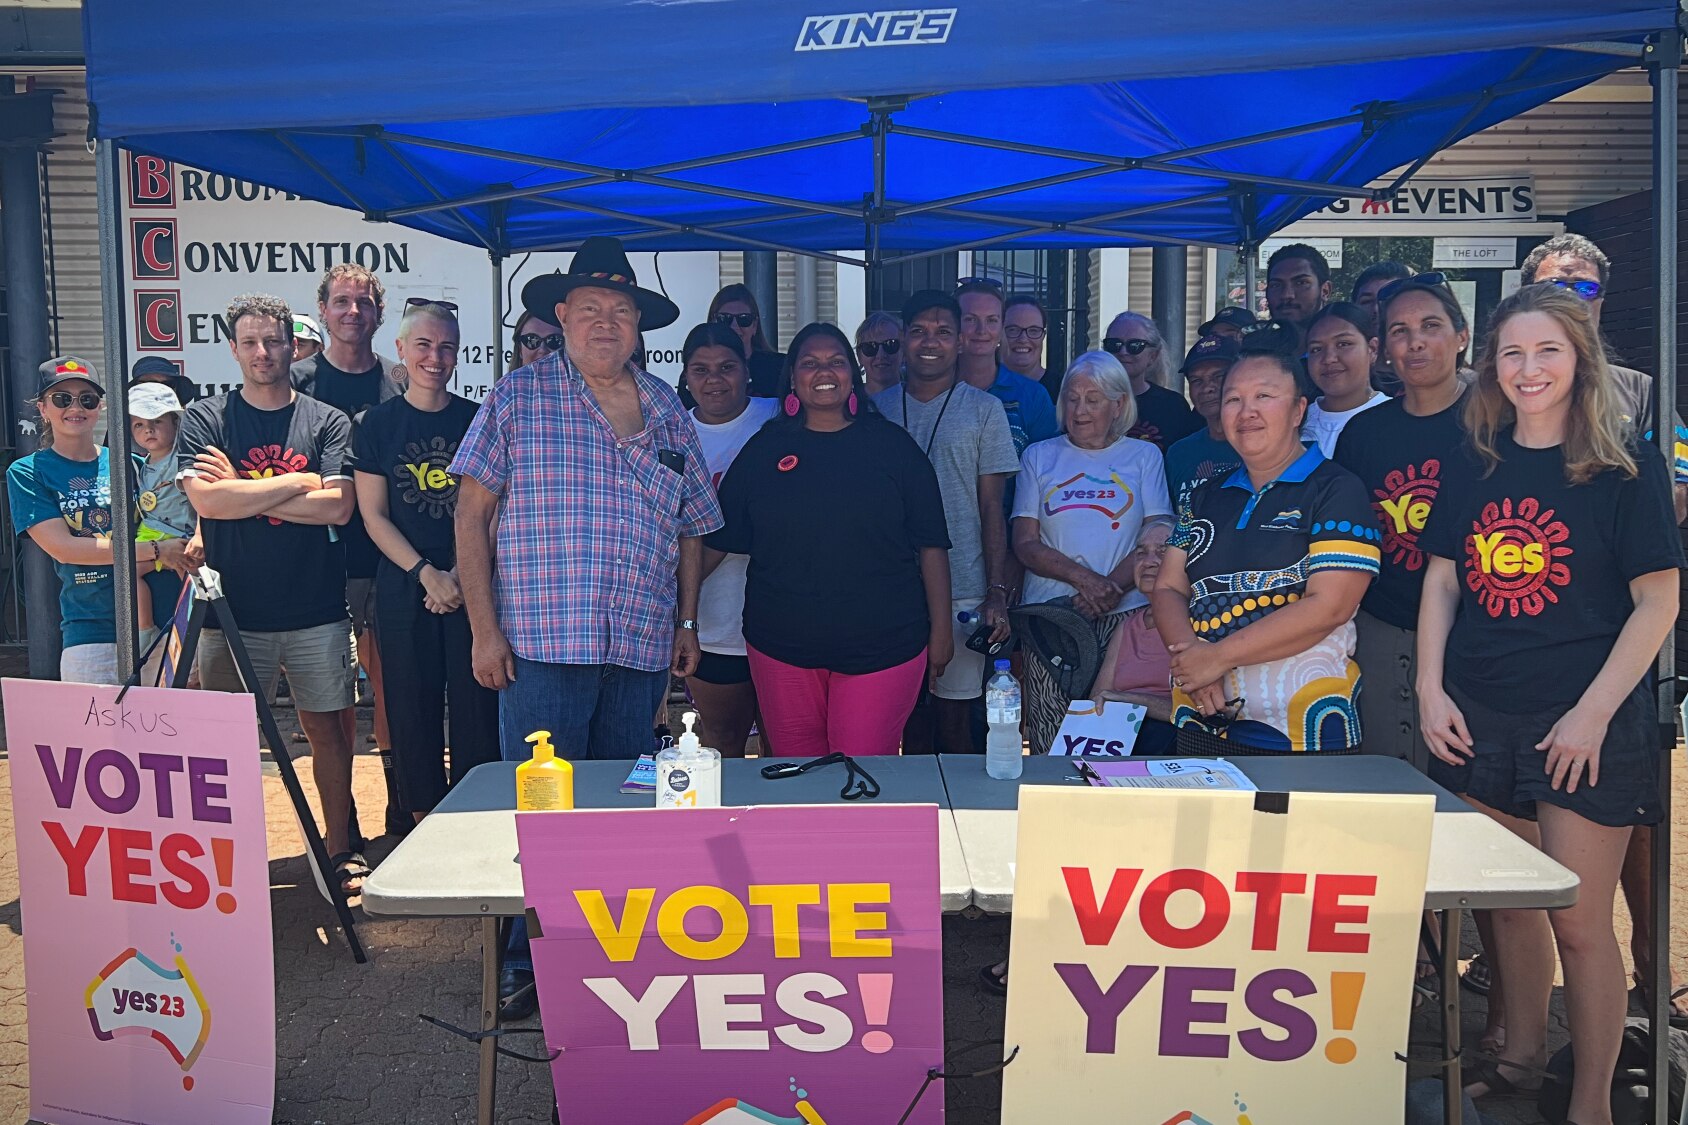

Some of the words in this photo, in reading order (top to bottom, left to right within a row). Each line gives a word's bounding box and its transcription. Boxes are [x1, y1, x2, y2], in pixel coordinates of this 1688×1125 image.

[797, 10, 955, 49] KINGS
[1393, 186, 1533, 214] EVENTS
[141, 227, 410, 273] CONVENTION
[1453, 249, 1471, 257] THE
[1474, 249, 1498, 257] LOFT
[462, 345, 482, 363] 12
[1061, 490, 1116, 501] yes23
[1380, 494, 1432, 534] Ye
[1473, 532, 1545, 574] Yes
[1063, 734, 1125, 756] YES
[34, 744, 233, 824] VOTE
[41, 820, 238, 915] YES!
[573, 883, 893, 962] VOTE
[1061, 866, 1378, 954] VOTE
[112, 987, 186, 1018] yes23
[582, 972, 894, 1054] YES!
[1053, 962, 1367, 1065] YES!
